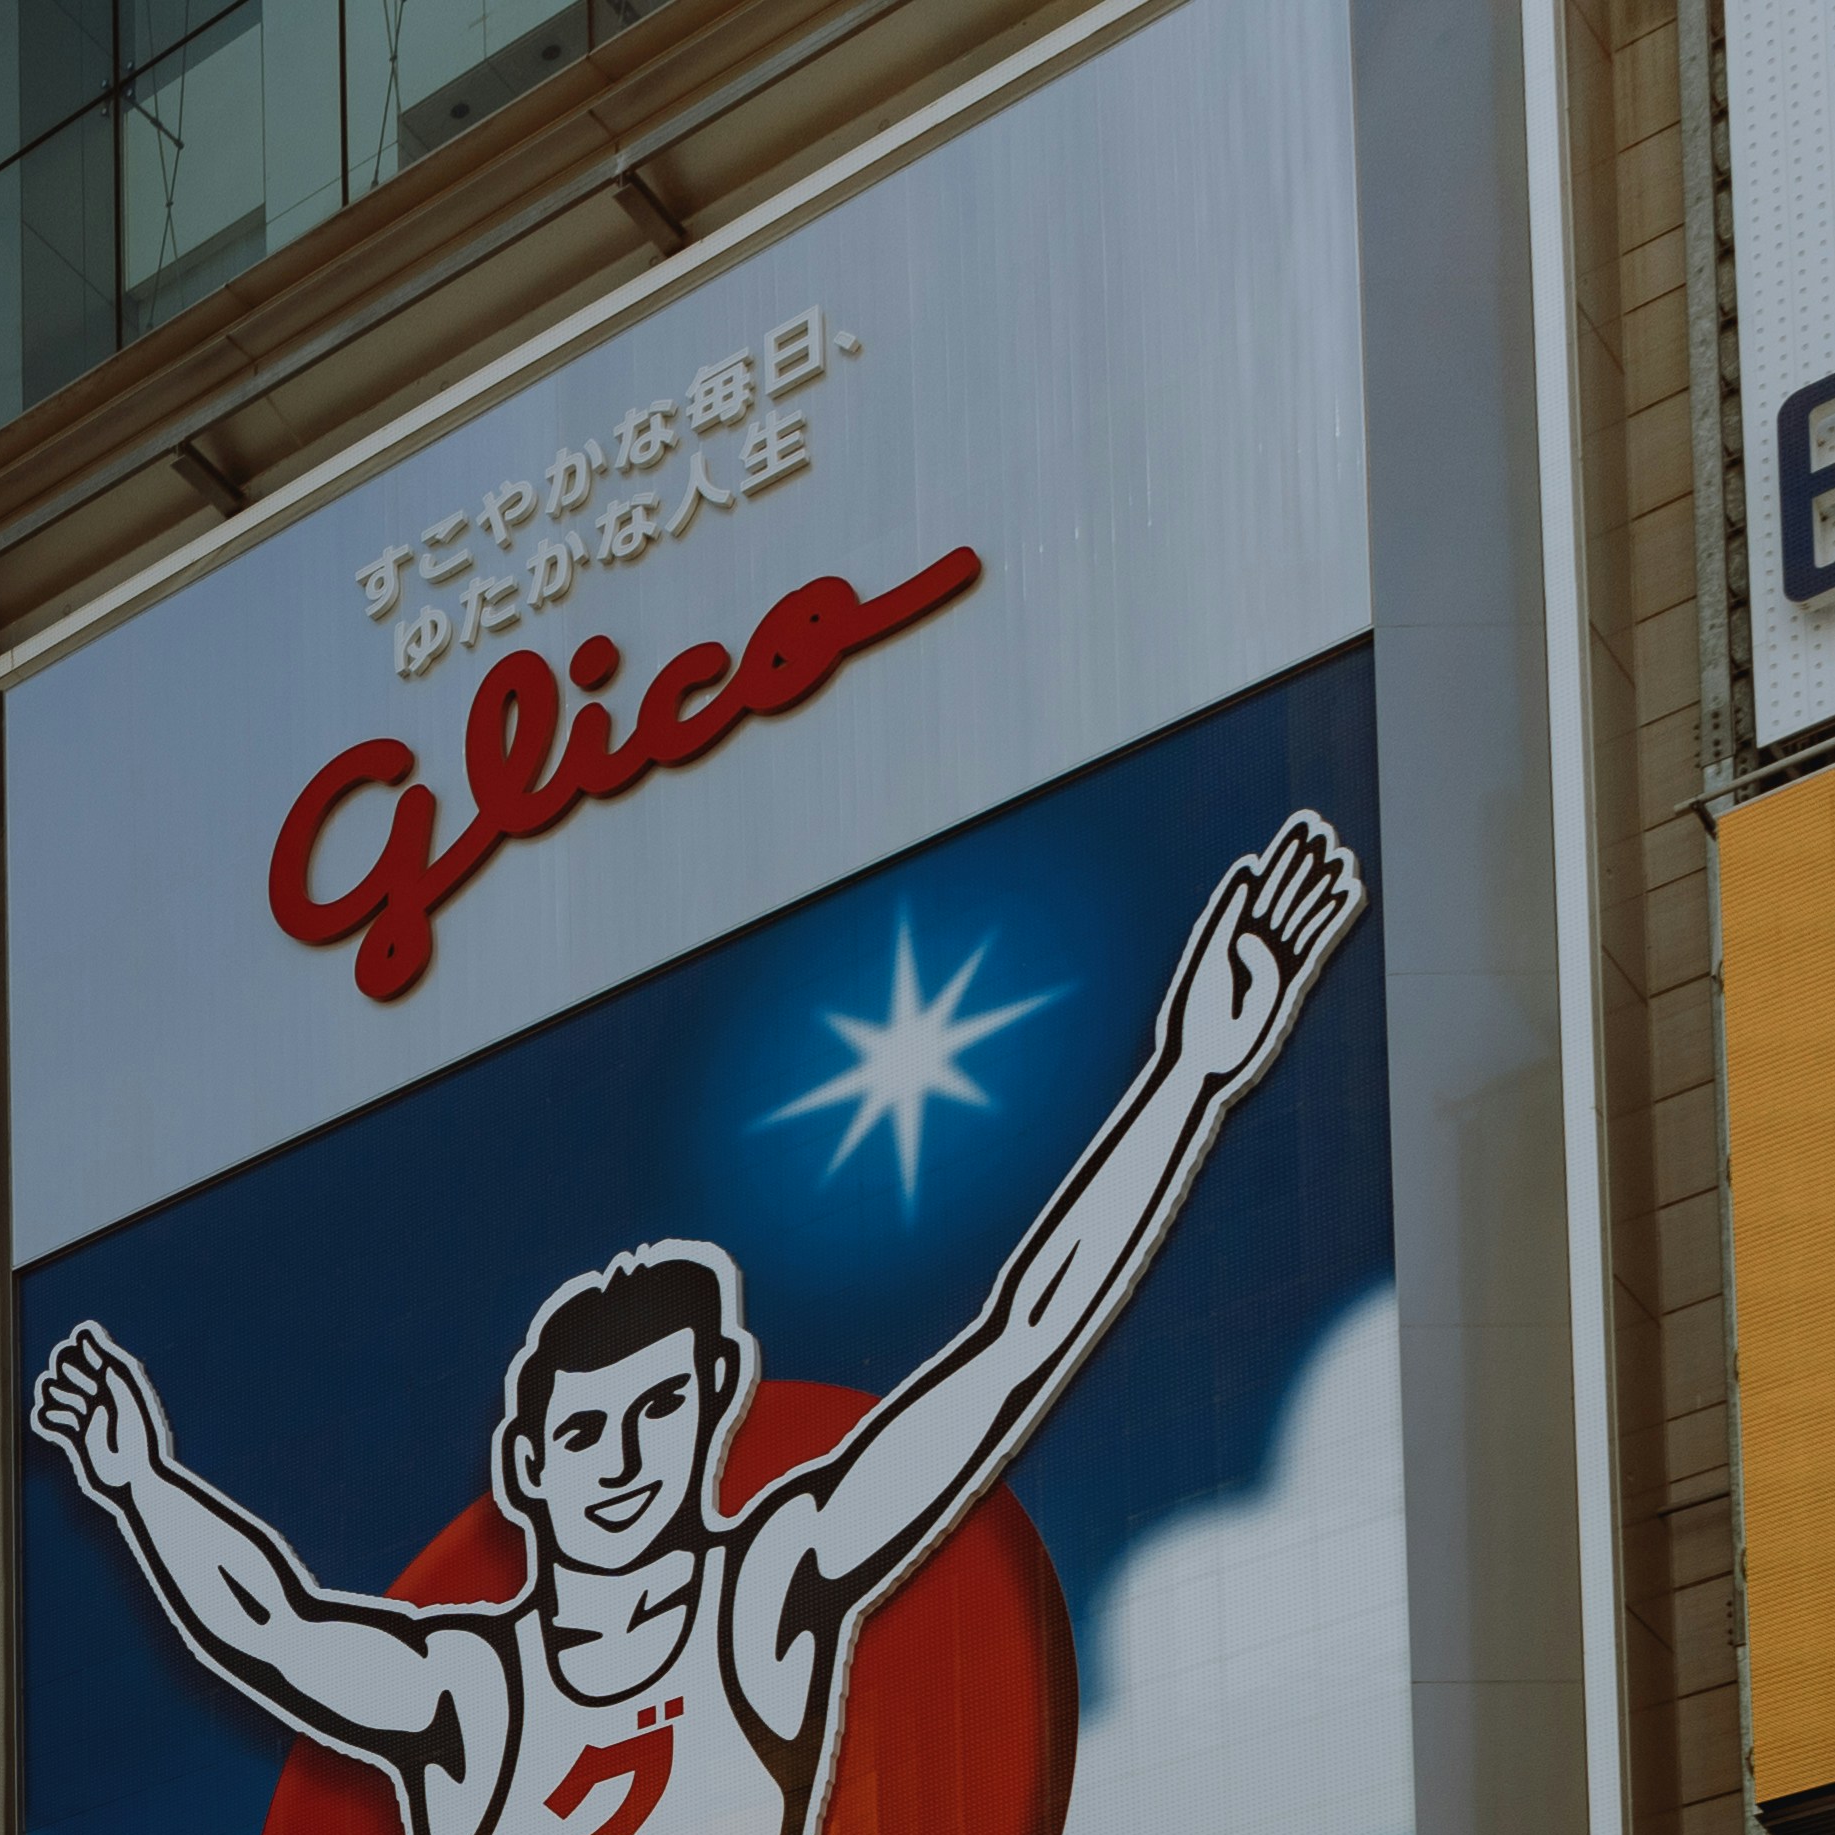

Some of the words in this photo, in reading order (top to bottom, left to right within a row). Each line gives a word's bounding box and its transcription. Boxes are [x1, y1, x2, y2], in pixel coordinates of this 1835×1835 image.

[391, 409, 813, 681] ゆたかな人生
